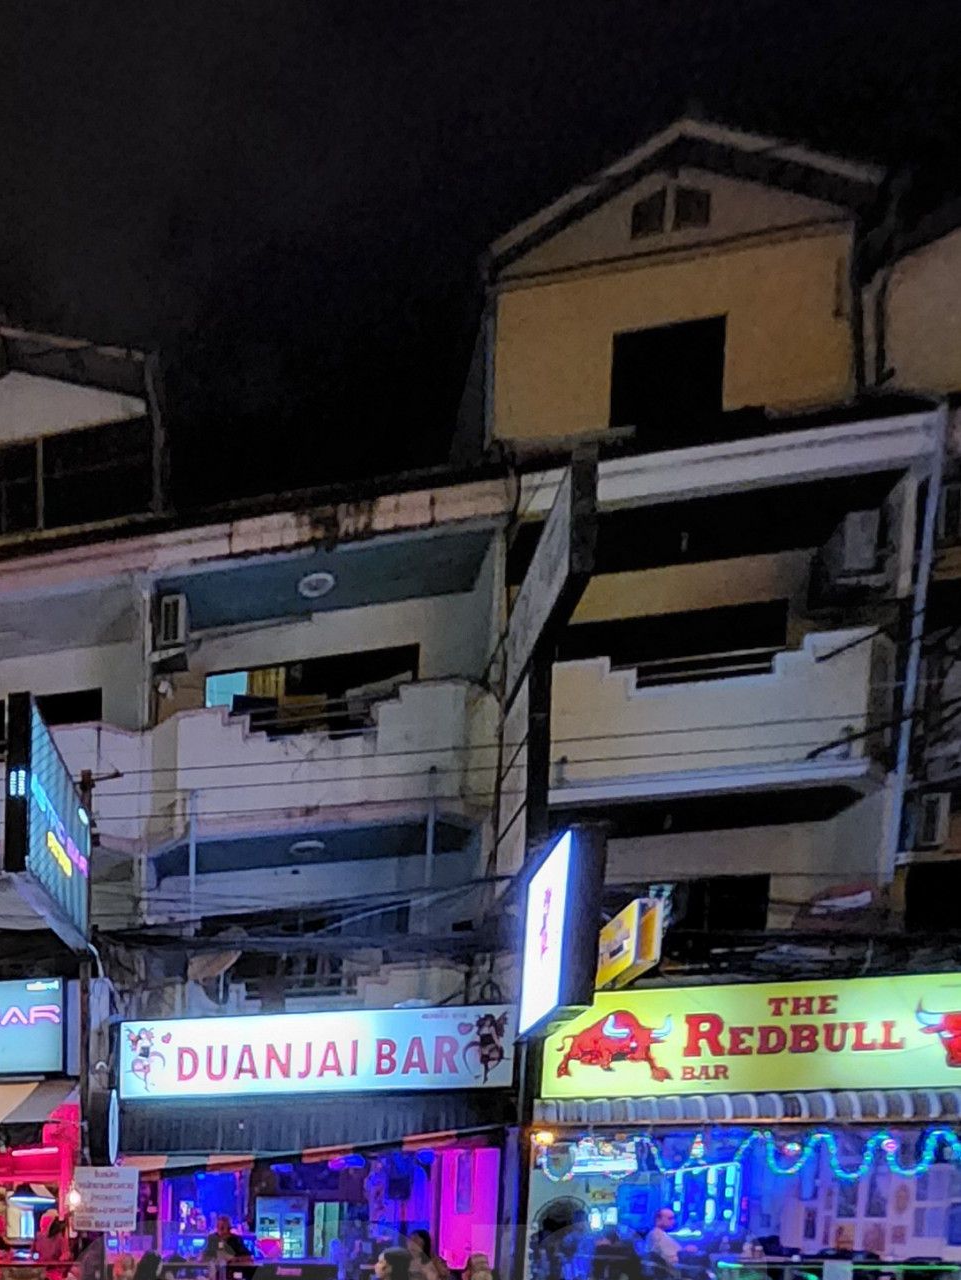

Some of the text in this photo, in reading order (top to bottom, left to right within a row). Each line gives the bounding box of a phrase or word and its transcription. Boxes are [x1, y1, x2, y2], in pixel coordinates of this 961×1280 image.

[767, 995, 839, 1017] THE
[682, 1012, 905, 1058] REDBULL
[176, 1035, 460, 1082] DUANJAI BAR
[680, 1065, 730, 1081] BAR
